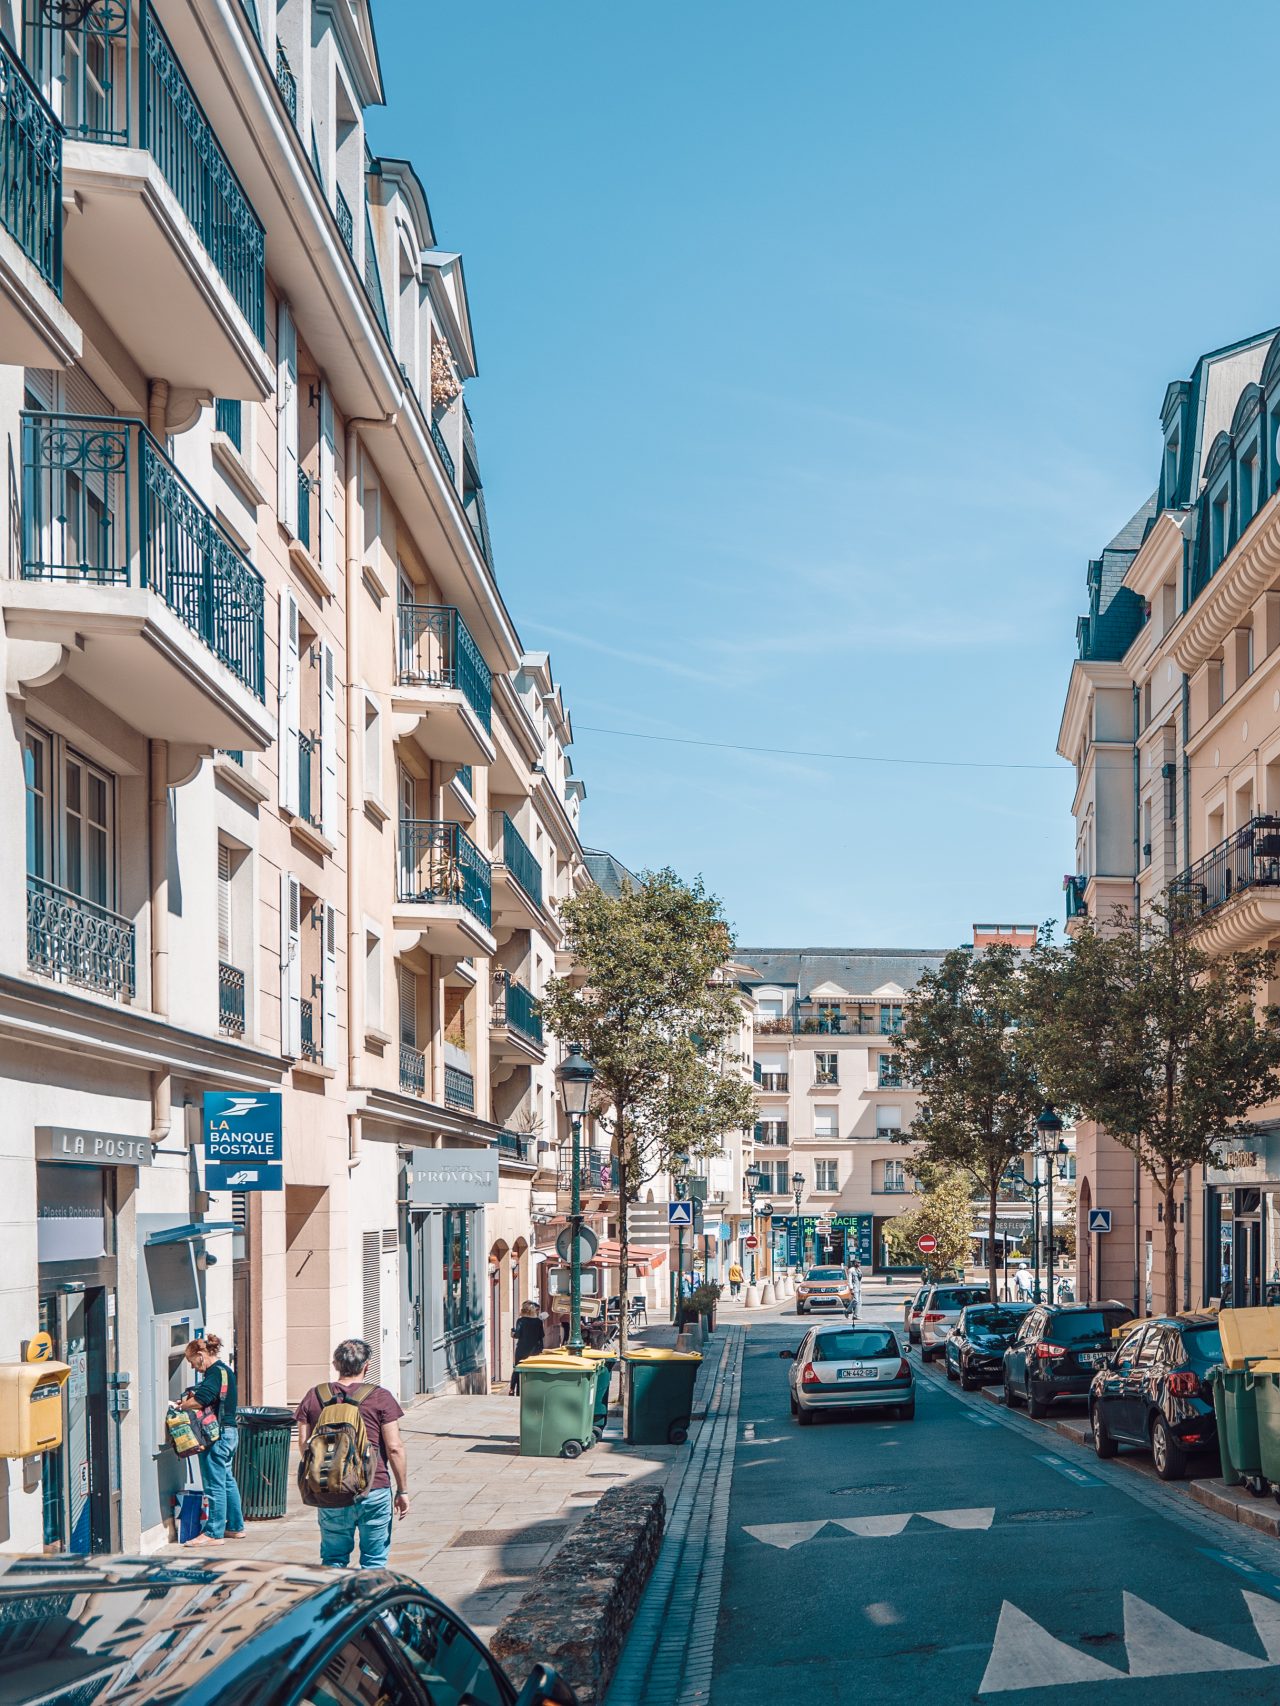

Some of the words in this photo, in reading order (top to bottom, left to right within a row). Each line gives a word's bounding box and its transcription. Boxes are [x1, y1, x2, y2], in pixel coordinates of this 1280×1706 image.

[209, 1120, 230, 1130] LA
[210, 1132, 274, 1144] BANQUE
[62, 1135, 85, 1154] LA
[94, 1138, 145, 1159] POSTE
[210, 1144, 275, 1155] POSTALE
[416, 1170, 494, 1182] PROVOST
